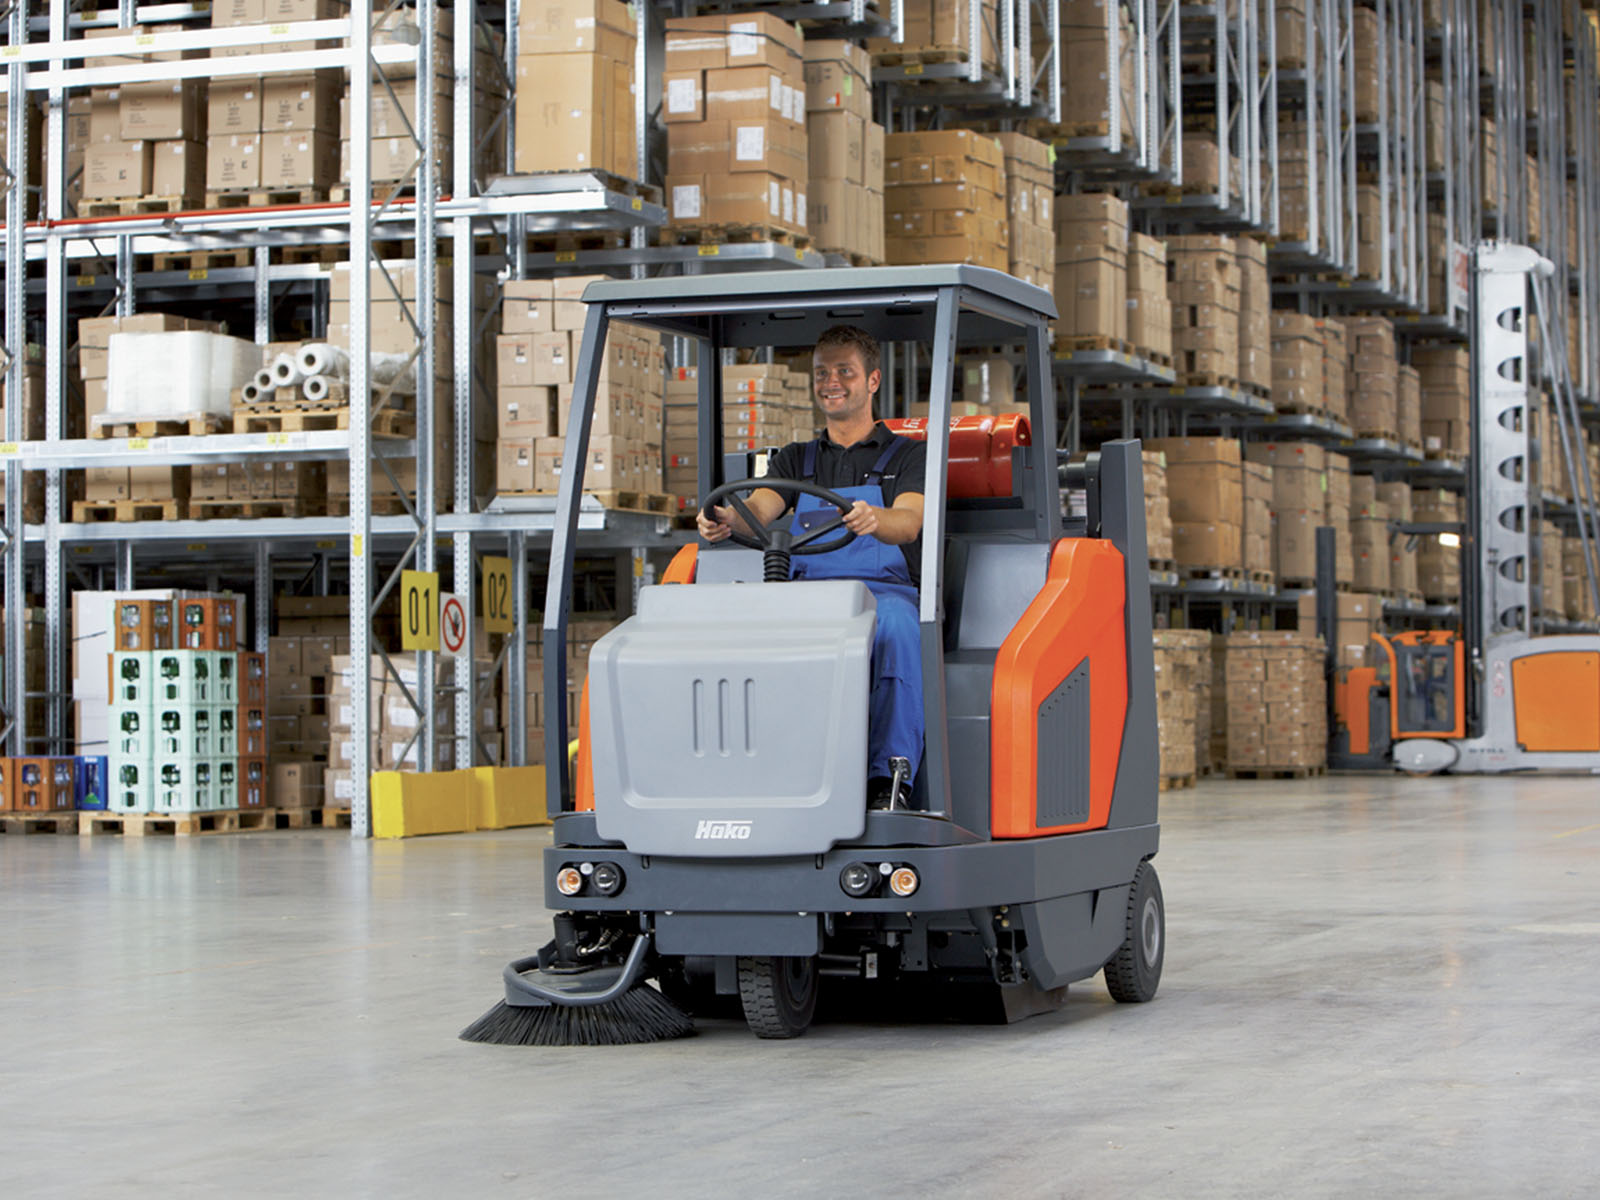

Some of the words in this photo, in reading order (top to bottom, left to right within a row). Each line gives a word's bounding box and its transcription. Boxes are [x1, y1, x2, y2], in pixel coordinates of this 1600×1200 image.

[409, 586, 430, 637] 01
[488, 572, 508, 620] 02
[695, 820, 752, 840] Hako
